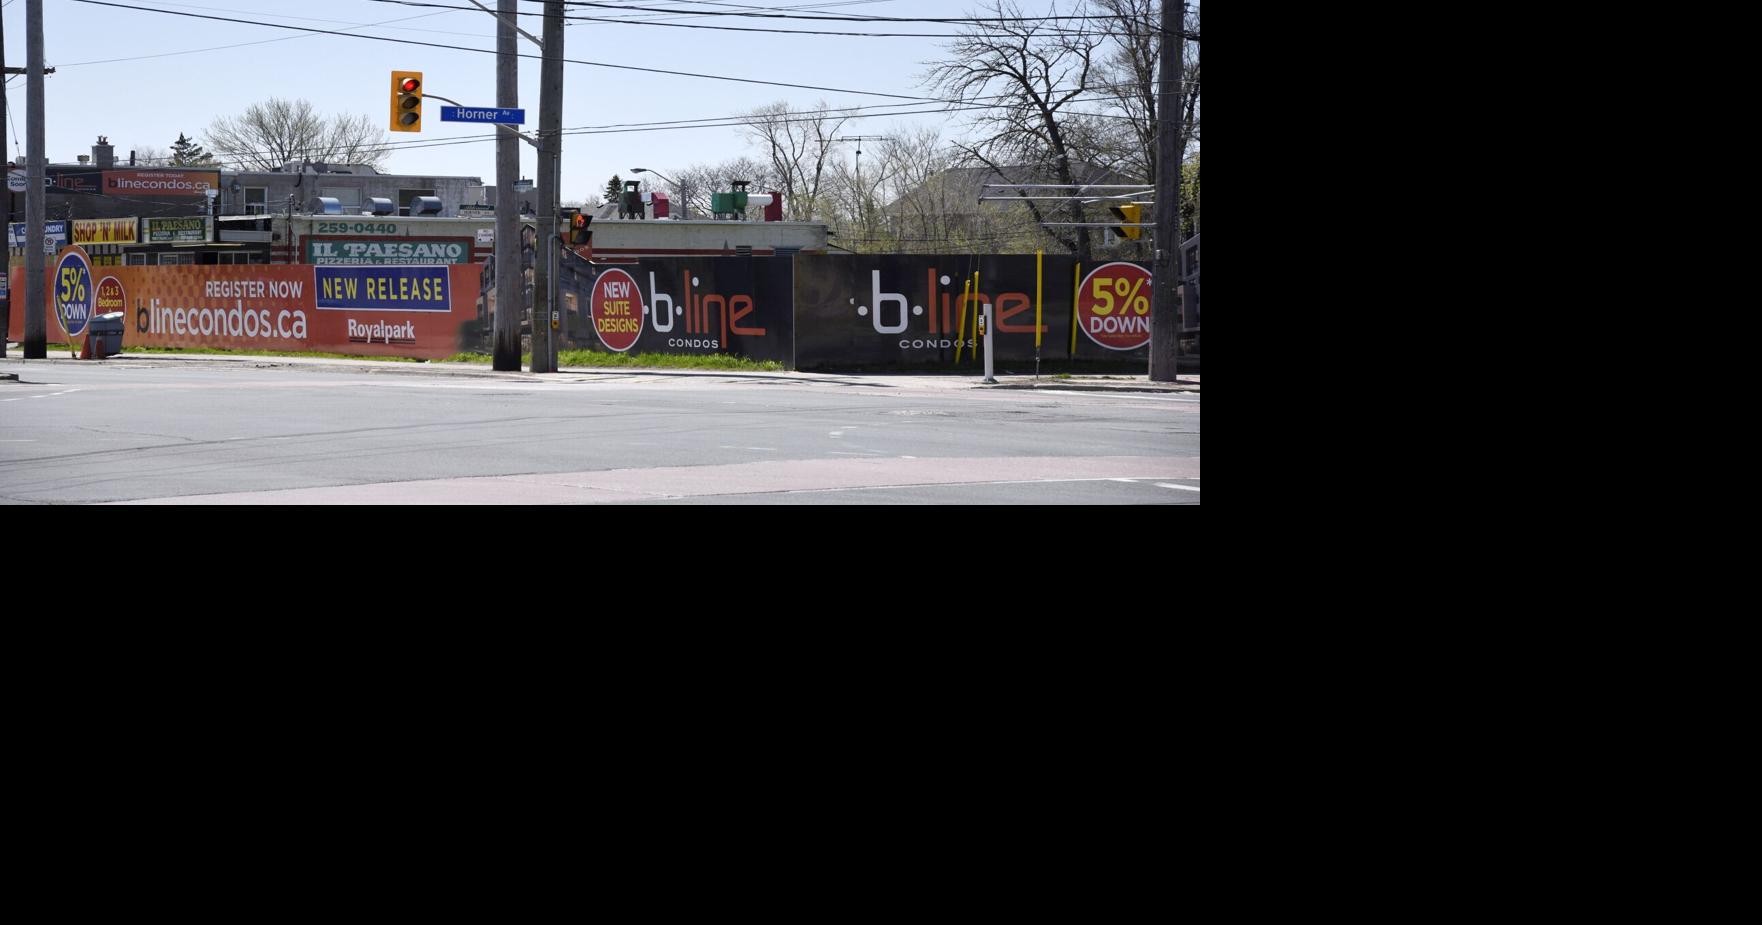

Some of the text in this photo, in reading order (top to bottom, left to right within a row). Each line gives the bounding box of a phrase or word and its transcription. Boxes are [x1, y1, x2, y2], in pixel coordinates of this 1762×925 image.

[457, 108, 498, 120] Horner
[108, 177, 210, 190] blinecondos.ca
[74, 222, 97, 242] SHOP
[114, 221, 135, 241] MILK
[161, 219, 201, 230] PAESANO
[318, 222, 397, 234] 259-0440
[312, 242, 462, 258] IL PAESANO
[316, 257, 373, 265] PIZZERIA
[383, 257, 458, 265] RESTAURANT
[205, 280, 303, 299] REGISTER NOW
[322, 277, 443, 301] NEW RELEASE
[603, 281, 630, 298] NEW
[98, 297, 123, 307] Bedroom
[603, 301, 630, 316] SUITE
[61, 303, 87, 320] DOWN
[136, 298, 307, 339] blinecondos.ca
[348, 318, 415, 344] Royalpark
[598, 318, 639, 333] DESIGNS
[1090, 316, 1150, 333] DOWN
[668, 338, 719, 348] CONDOS
[899, 339, 978, 349] CONDOS
